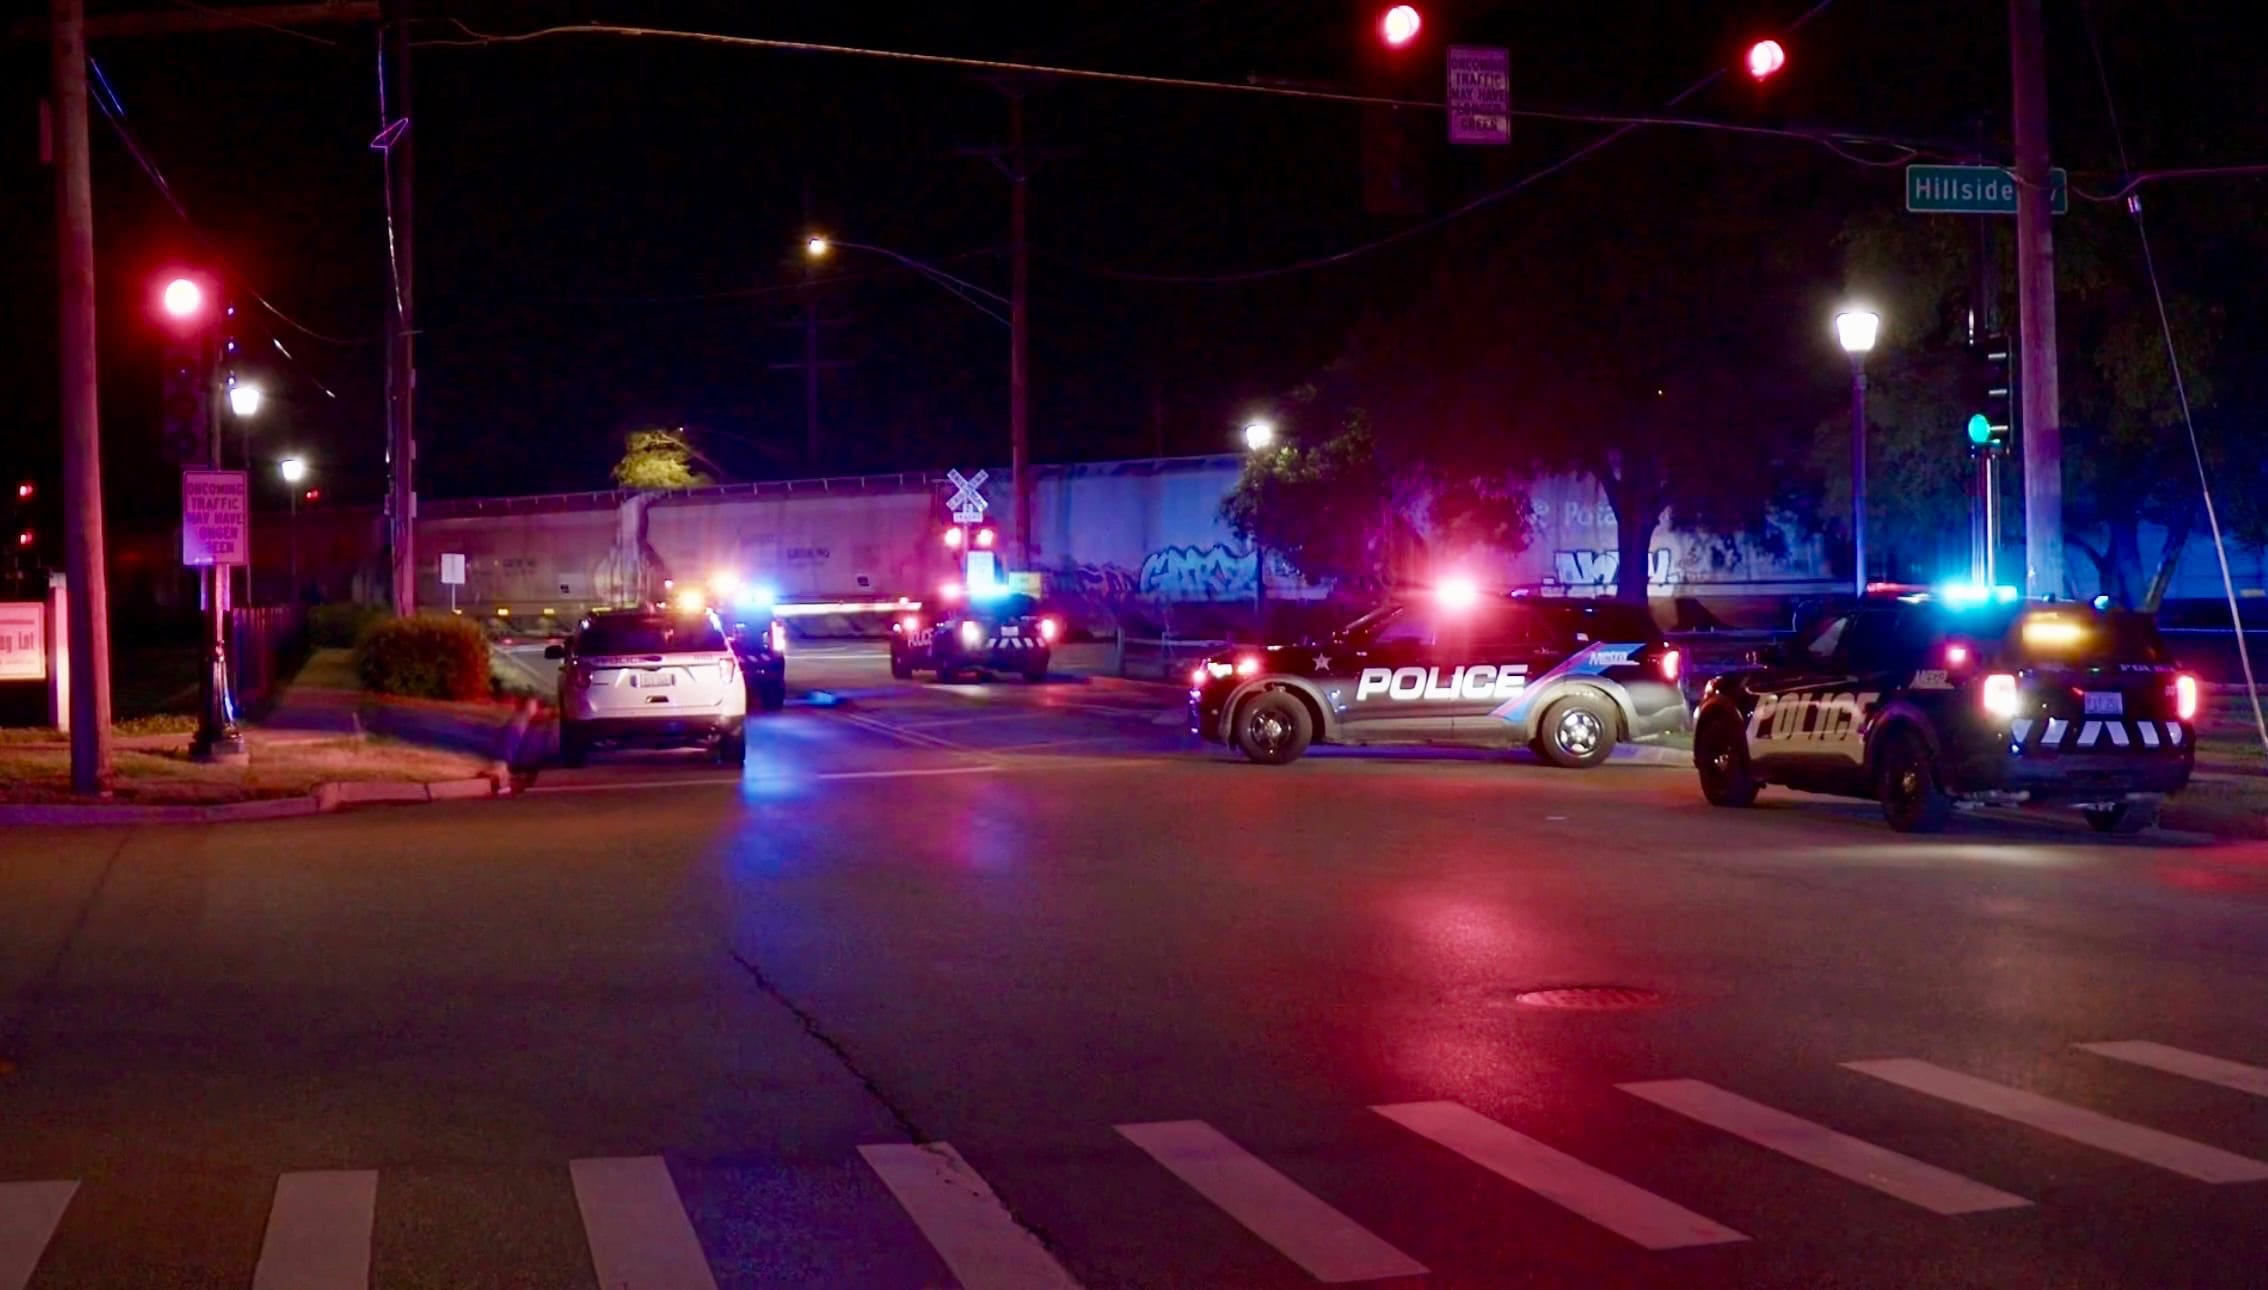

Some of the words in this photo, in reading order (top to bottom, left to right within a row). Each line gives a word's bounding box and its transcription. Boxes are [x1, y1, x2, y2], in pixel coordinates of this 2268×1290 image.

[1456, 72, 1502, 86] TRAFFIC
[1451, 88, 1474, 100] MAY
[1478, 88, 1505, 100] HAVE
[1915, 177, 2014, 201] Hillside
[187, 482, 243, 495] ONCOMING
[191, 497, 240, 510] TRAFFIC
[214, 512, 244, 525] HAVE
[194, 527, 239, 540] ONGER
[1356, 664, 1528, 701] POLICE
[1748, 692, 1880, 741] POLICE
